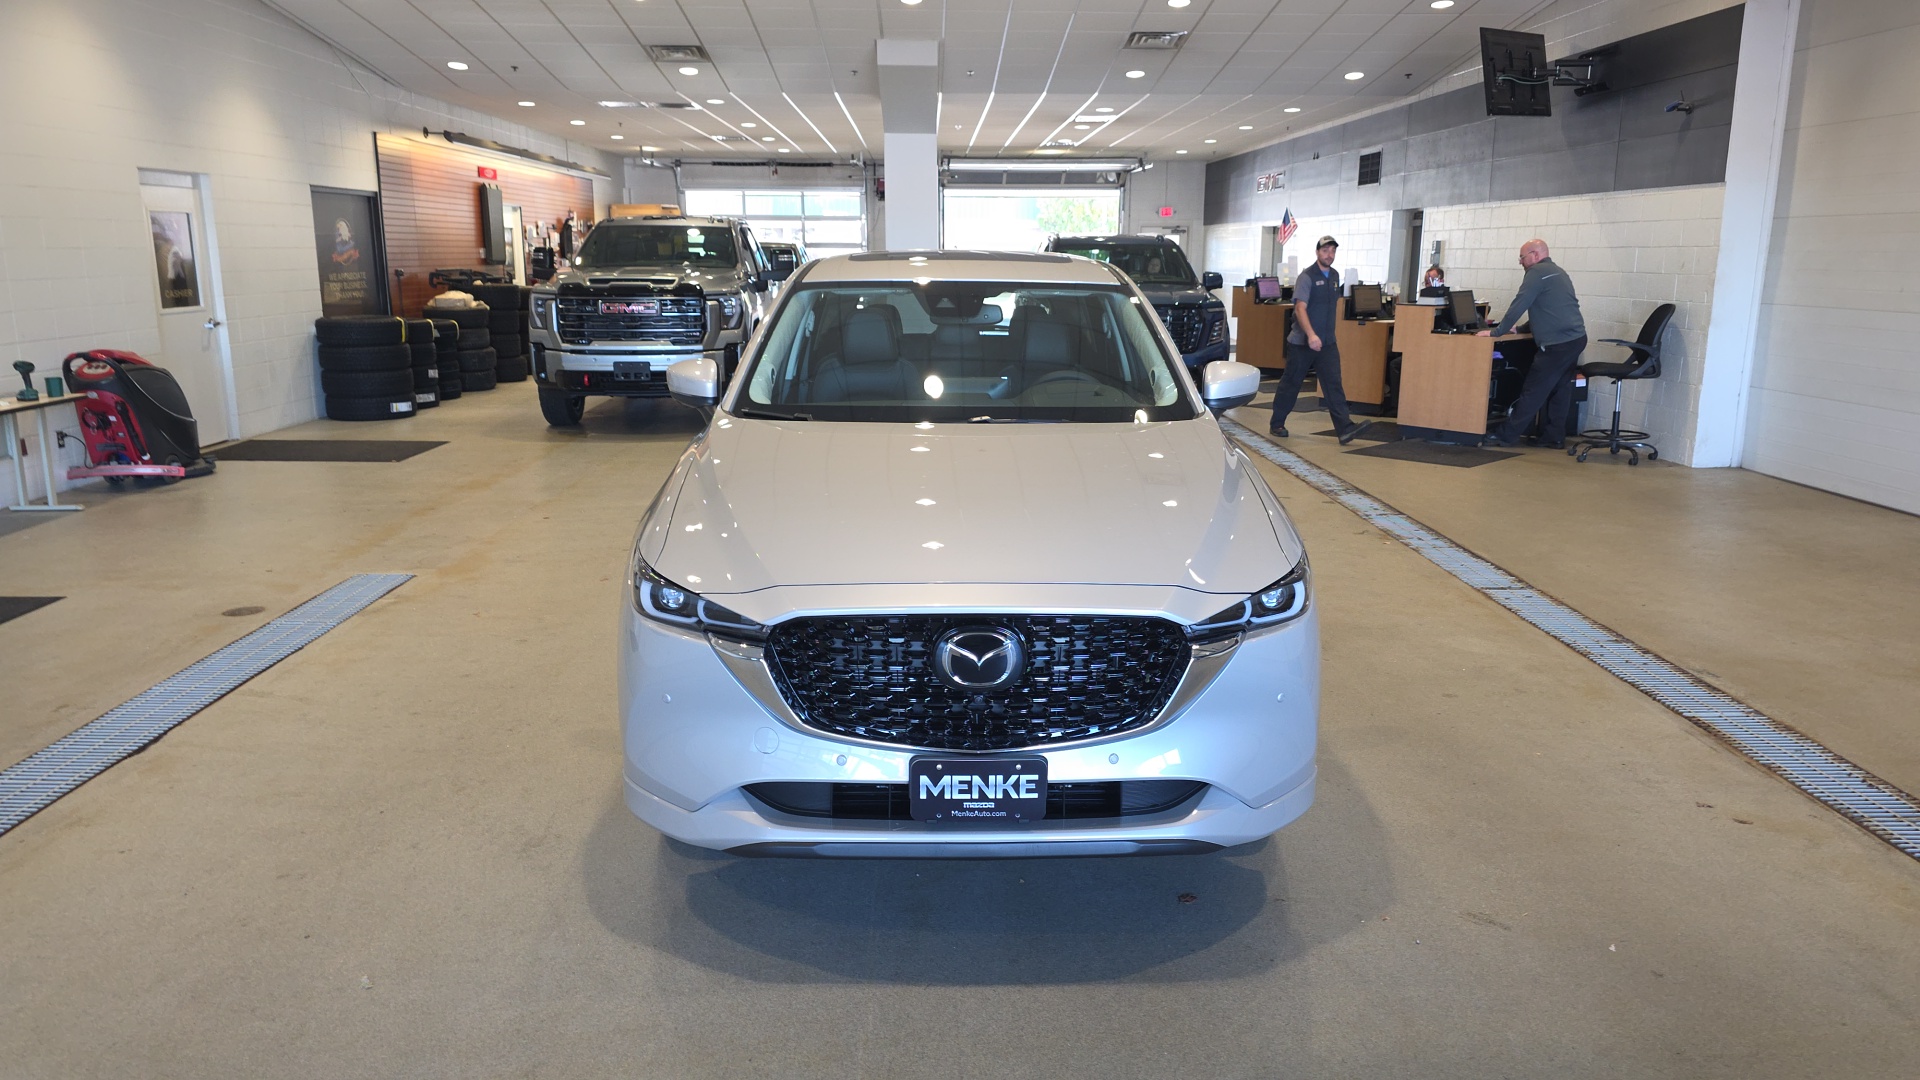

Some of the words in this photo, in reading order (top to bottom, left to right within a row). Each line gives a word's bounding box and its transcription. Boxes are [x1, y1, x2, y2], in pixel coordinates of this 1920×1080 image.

[165, 289, 193, 299] CASHIER
[602, 302, 658, 314] GMC
[920, 774, 1039, 800] MENKE
